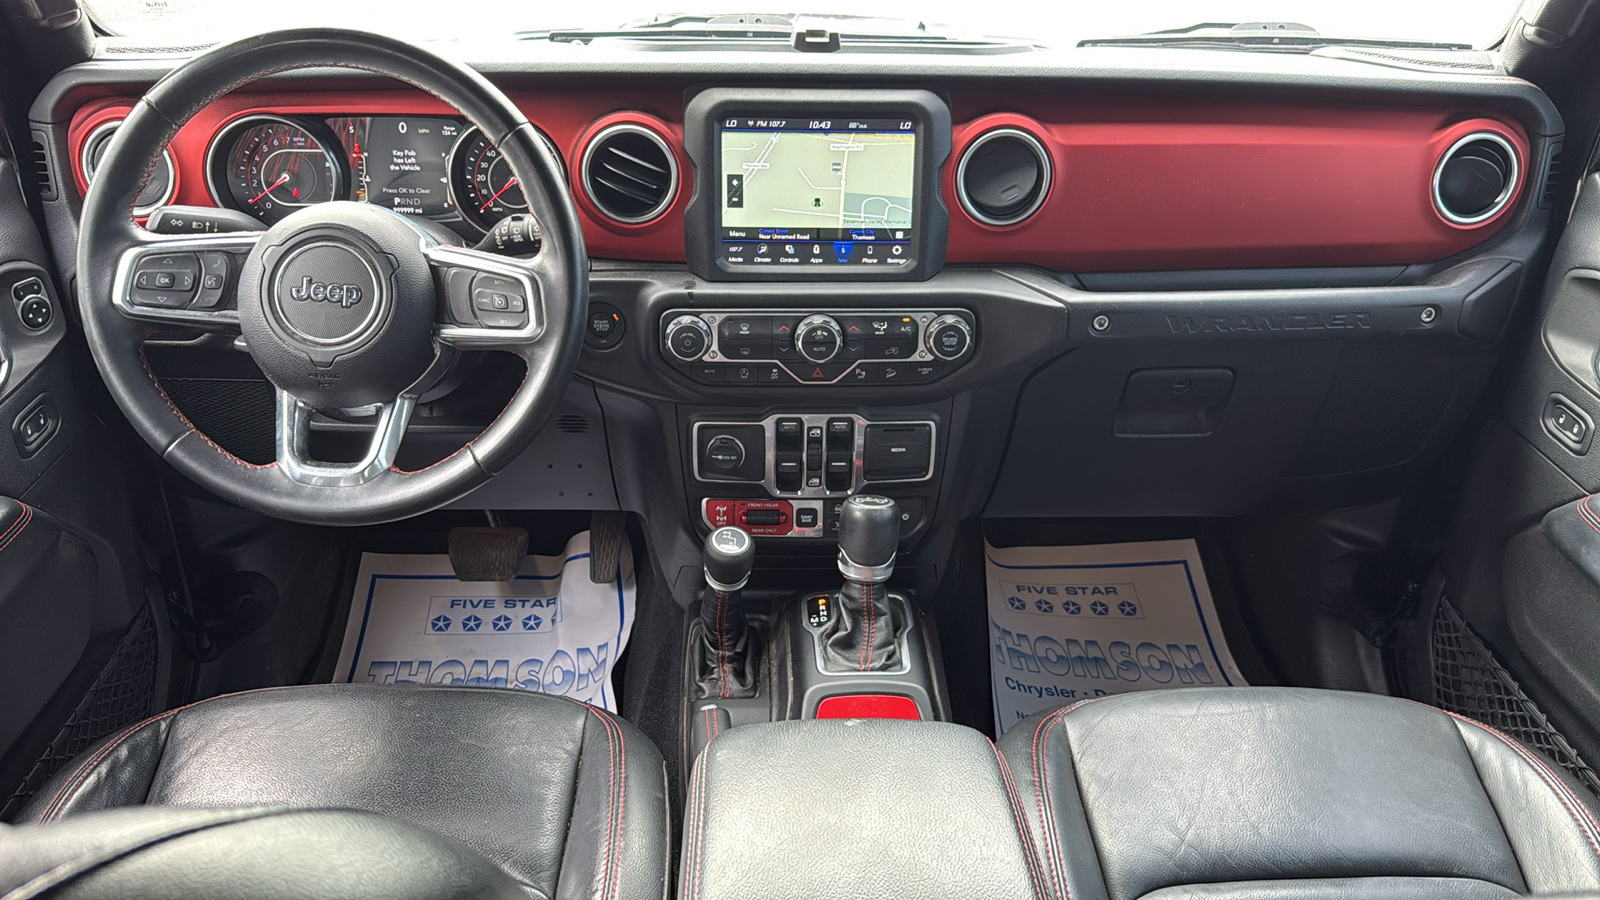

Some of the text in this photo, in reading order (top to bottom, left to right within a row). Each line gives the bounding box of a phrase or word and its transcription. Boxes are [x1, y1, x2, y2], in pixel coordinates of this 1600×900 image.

[398, 122, 408, 134] 0
[291, 276, 362, 308] Jeep
[1165, 312, 1372, 334] WRANGLER
[1016, 584, 1118, 596] FIVE STAR
[450, 598, 496, 609] FIVE
[1004, 676, 1076, 698] Chrysler
